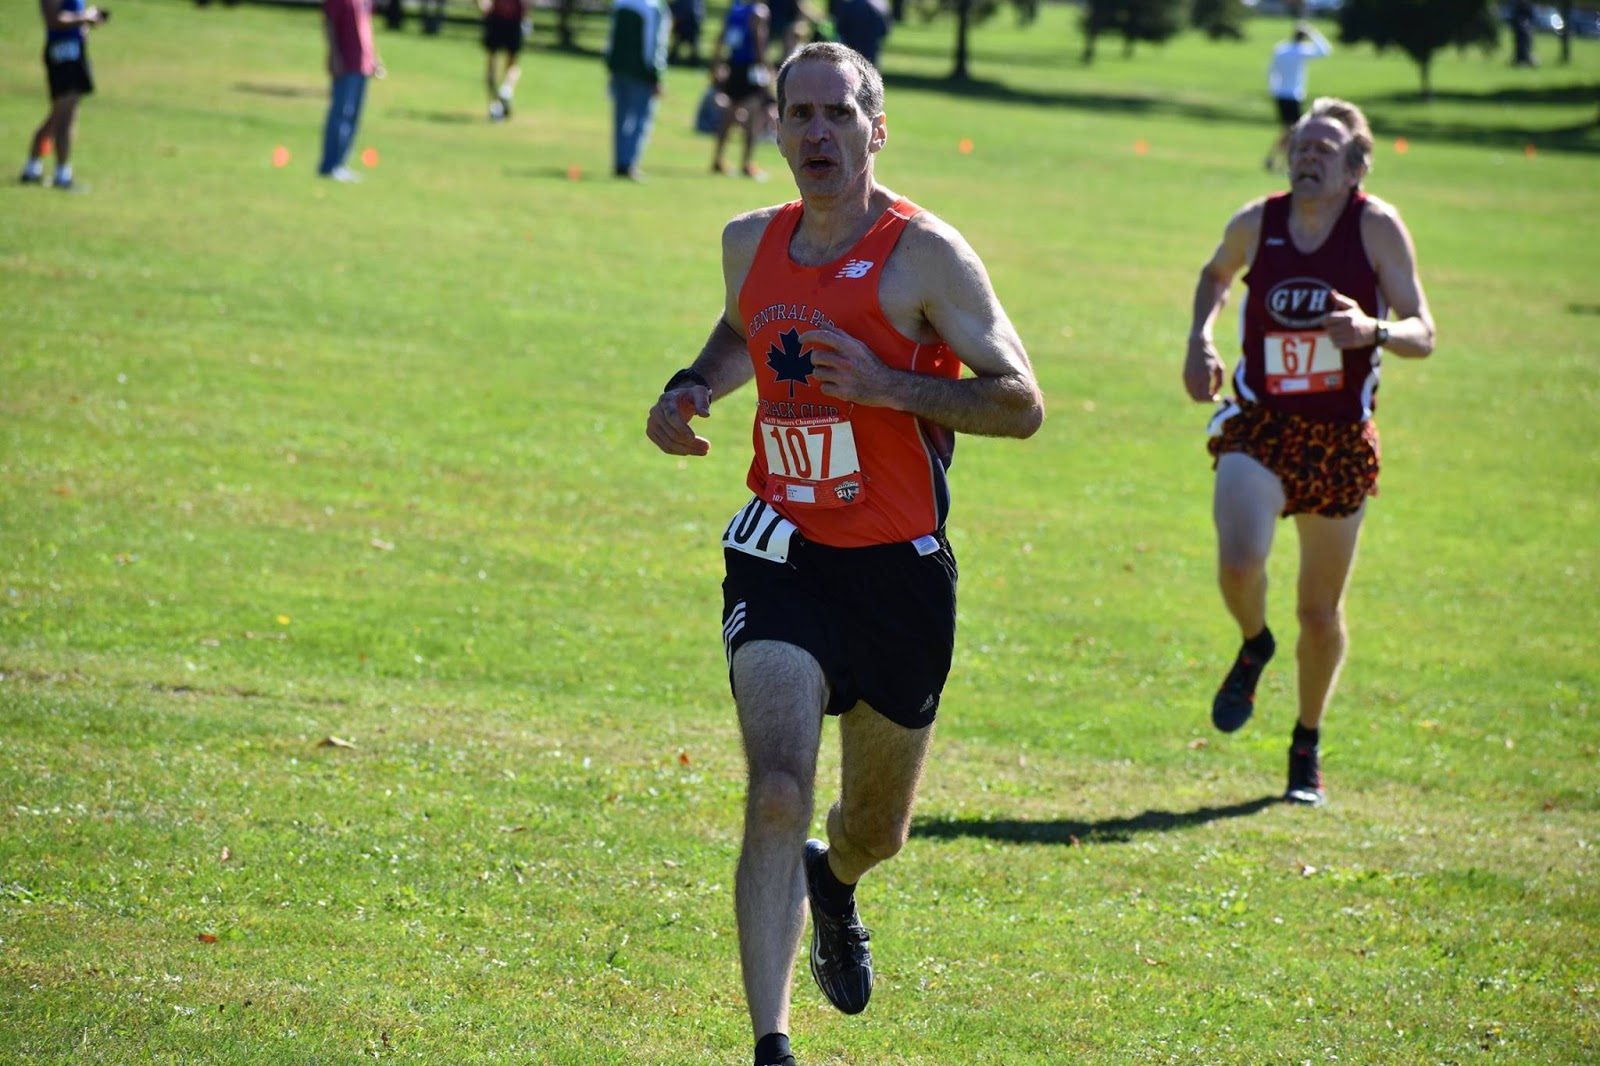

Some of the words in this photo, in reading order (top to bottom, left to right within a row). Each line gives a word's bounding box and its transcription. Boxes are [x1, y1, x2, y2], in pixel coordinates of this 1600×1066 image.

[1271, 288, 1328, 312] GVH
[748, 304, 807, 337] CENTRAL
[810, 309, 836, 328] PA
[1281, 337, 1316, 376] 67
[795, 416, 840, 426] Championship
[770, 425, 832, 479] 107
[772, 494, 784, 503] 107
